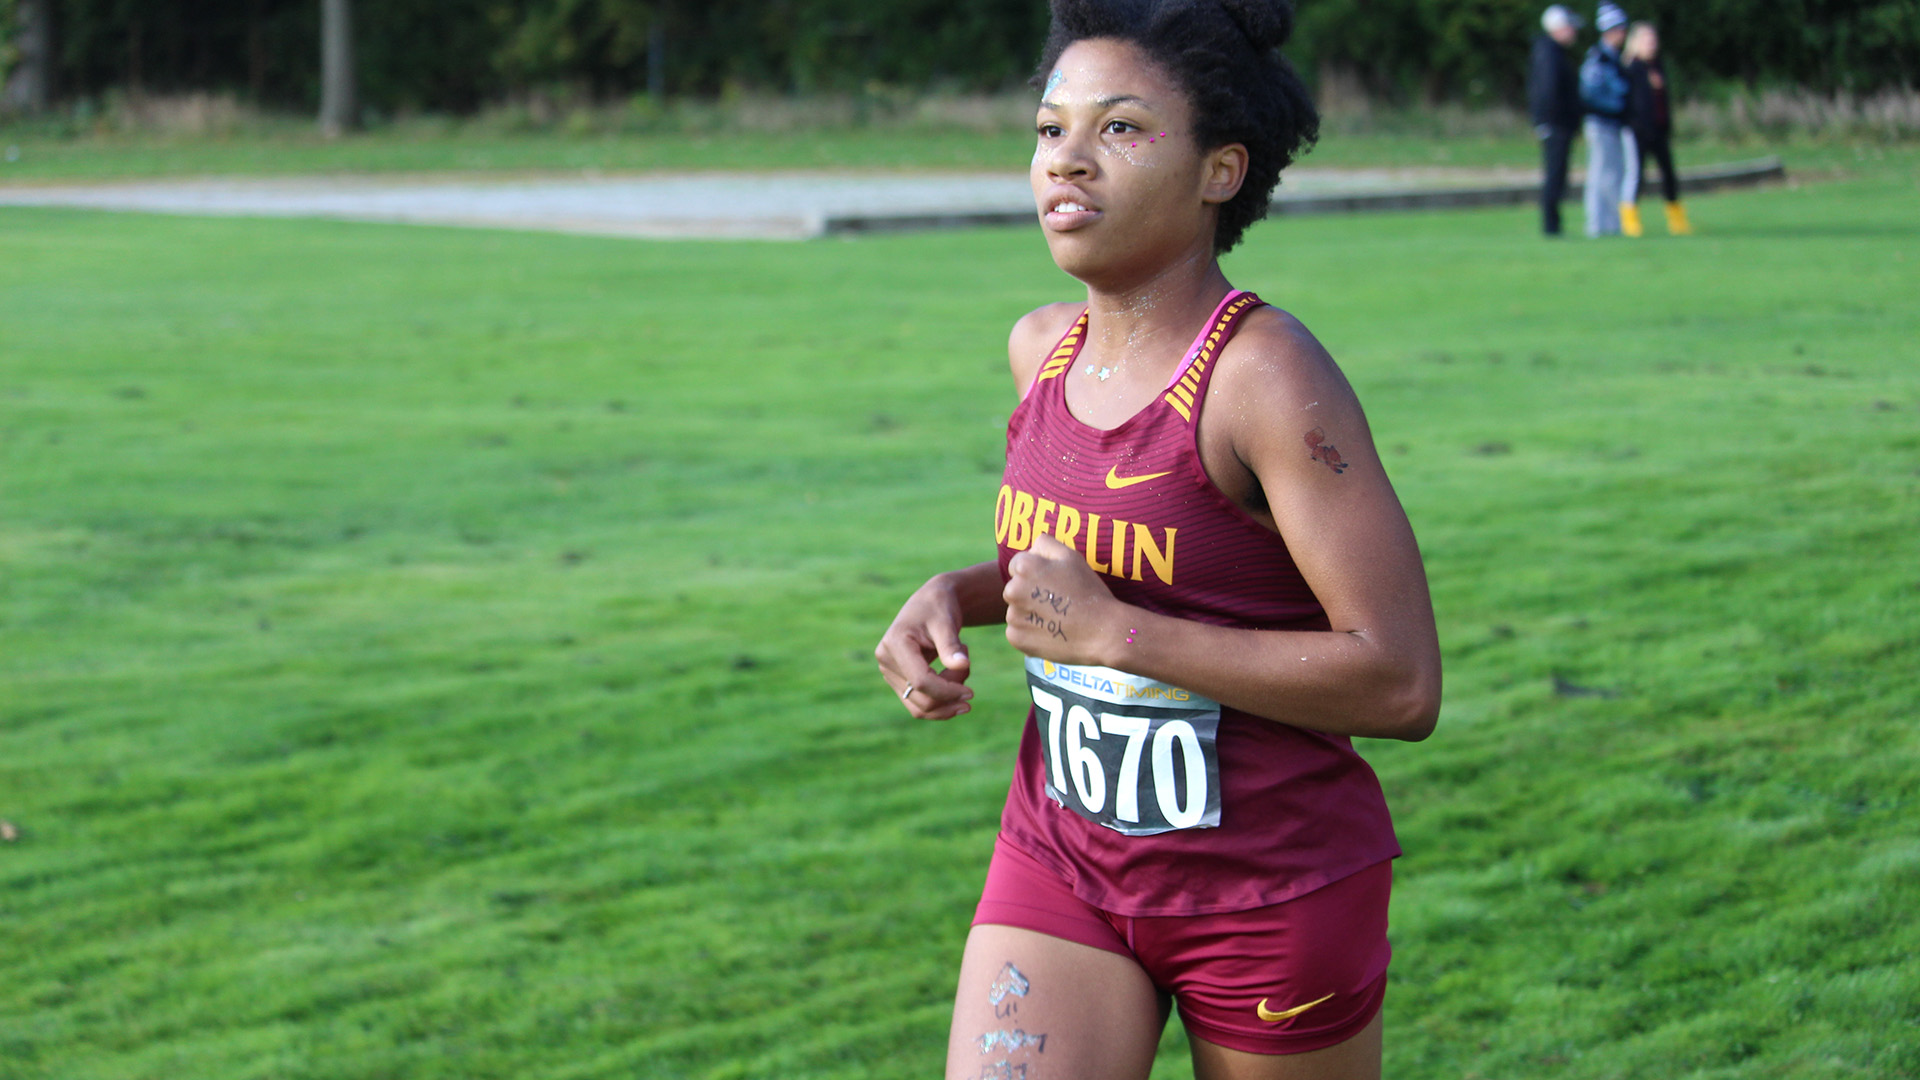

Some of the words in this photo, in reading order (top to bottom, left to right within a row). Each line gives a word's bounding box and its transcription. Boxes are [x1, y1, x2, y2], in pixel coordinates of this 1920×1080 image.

[995, 485, 1177, 585] OBERLIN
[1025, 611, 1067, 642] Your
[1031, 685, 1208, 829] 7670
